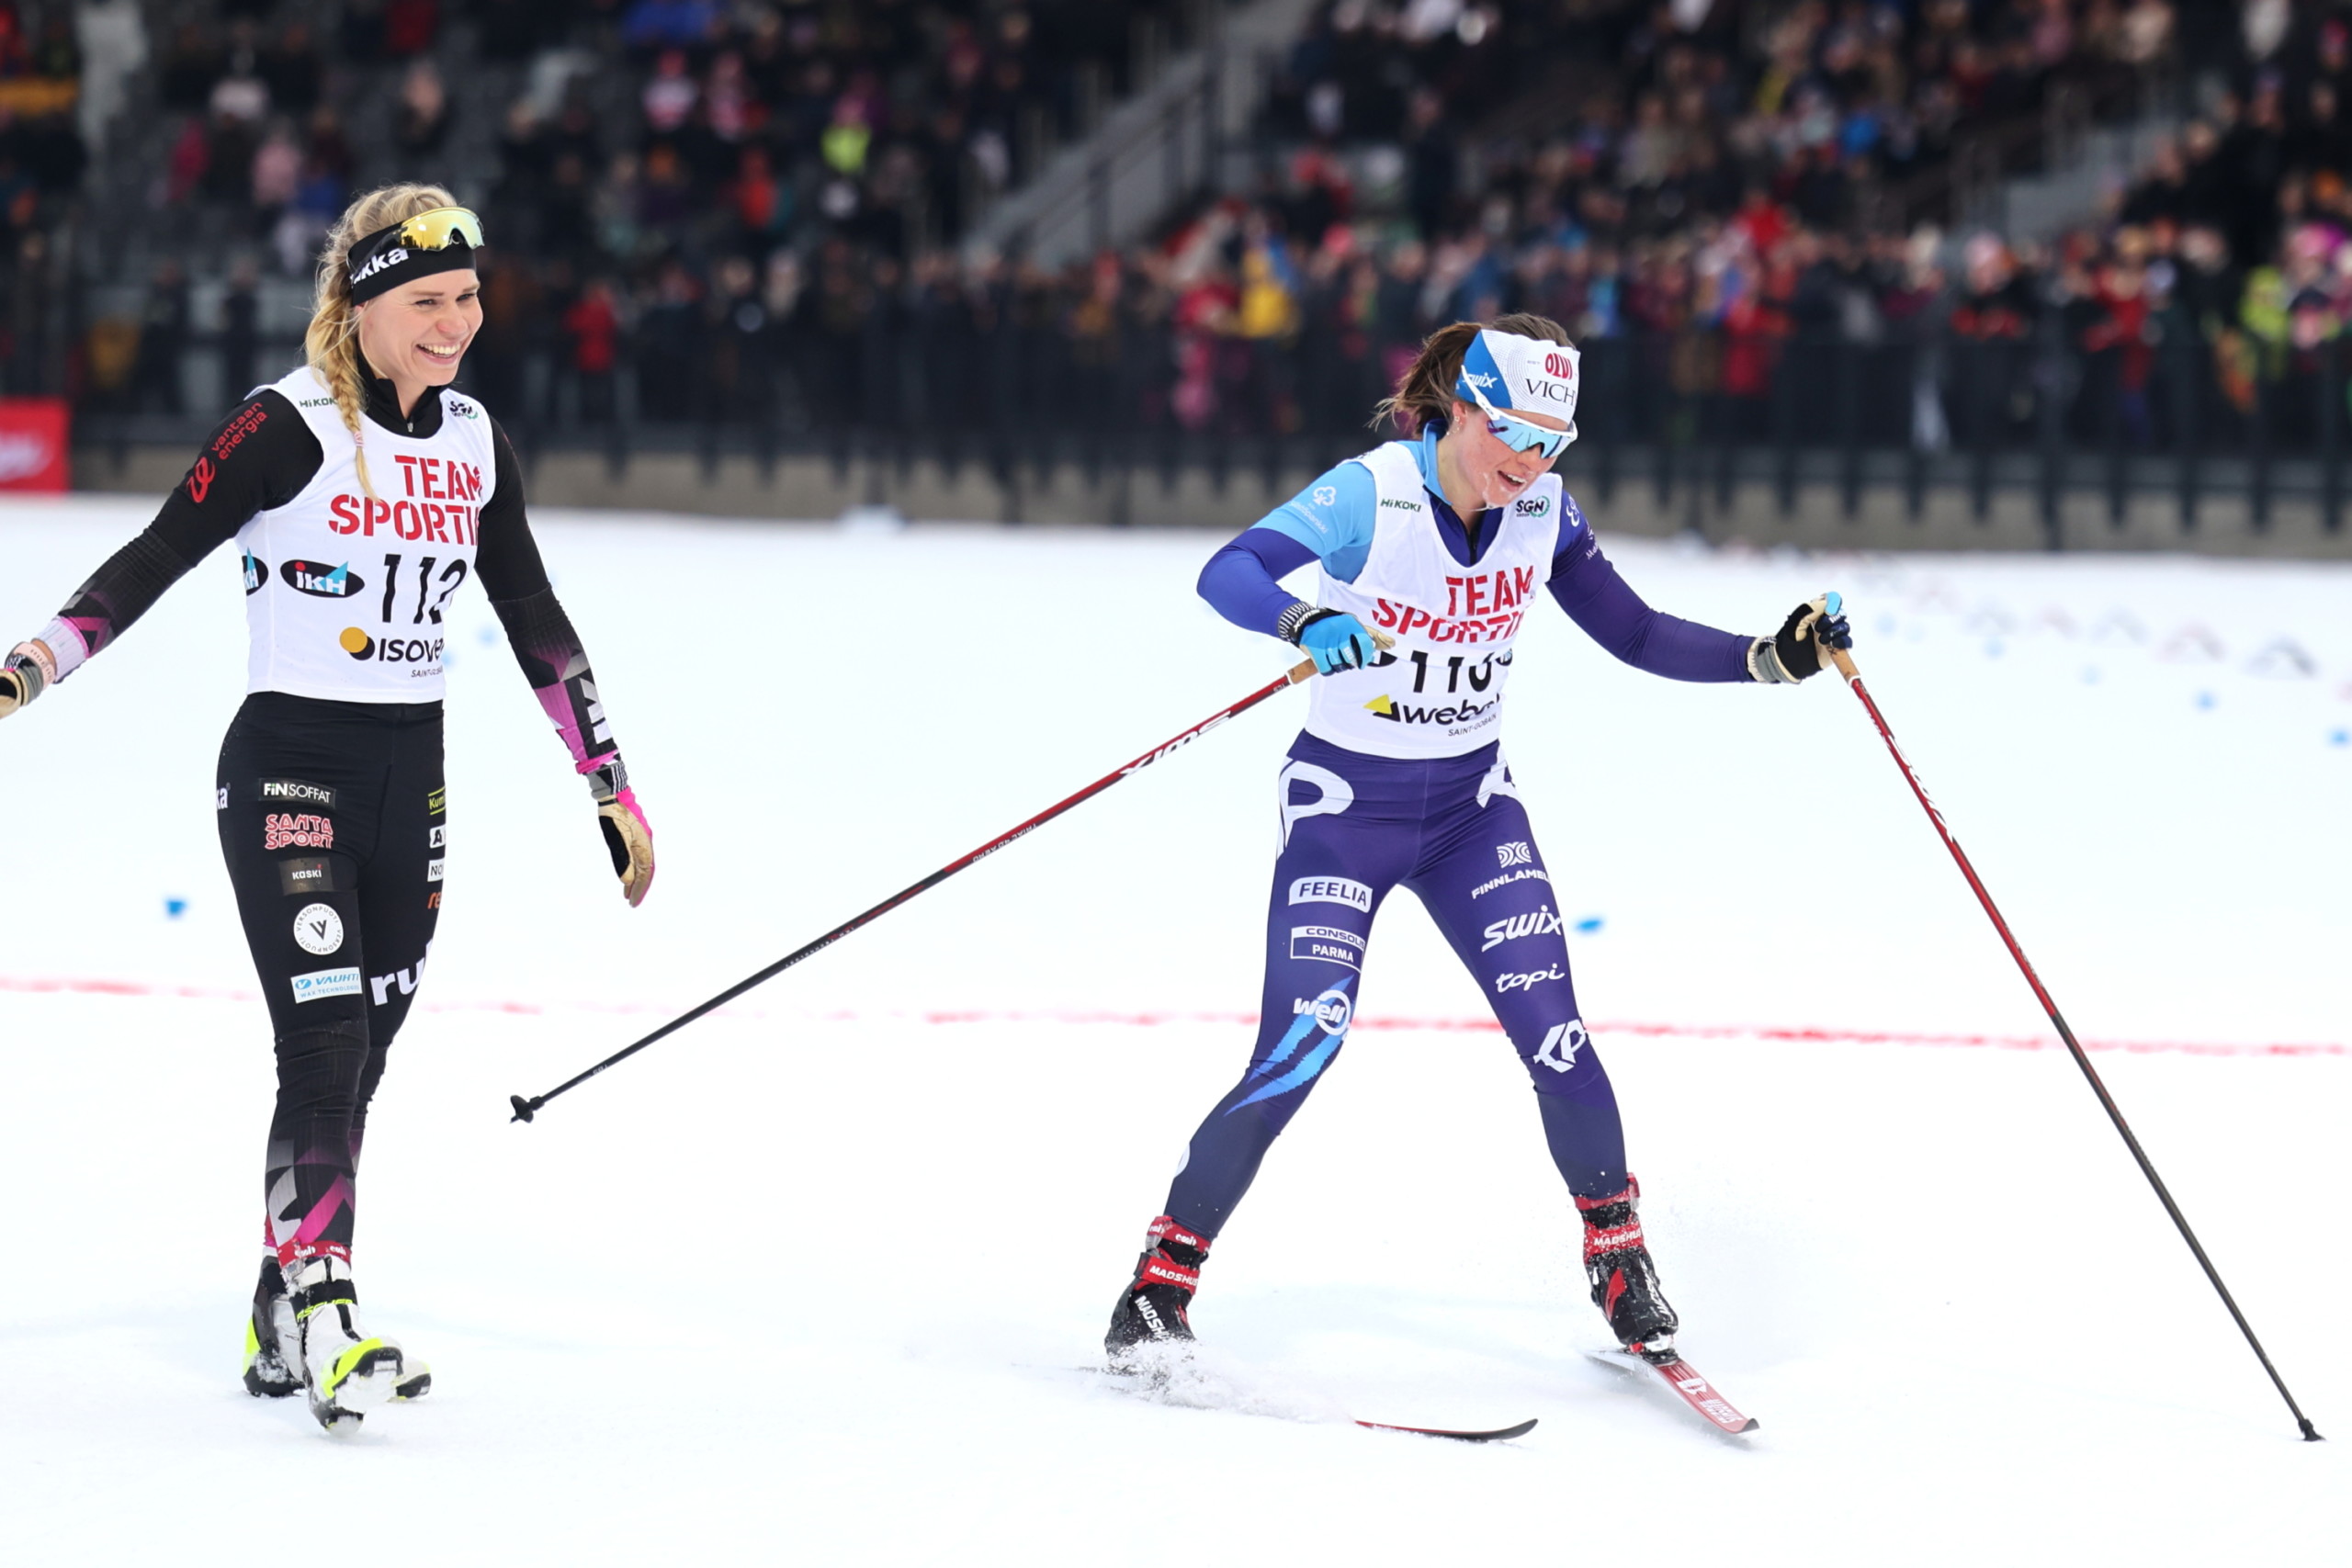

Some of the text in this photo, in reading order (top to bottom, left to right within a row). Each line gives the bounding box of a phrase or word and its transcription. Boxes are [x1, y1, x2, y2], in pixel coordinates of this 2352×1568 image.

[300, 397, 340, 408] HiKOK
[211, 401, 264, 452] vantaan
[218, 411, 268, 460] energia
[1516, 499, 1545, 513] SGN
[328, 494, 479, 547] SPORTI
[382, 553, 468, 626] 112
[1446, 565, 1534, 617] TEAM
[265, 813, 334, 835] SANTA
[265, 830, 334, 850] SPORT
[1298, 881, 1367, 908] FEELIA
[1312, 942, 1355, 964] PARMA
[315, 973, 360, 986] VAUHTI
